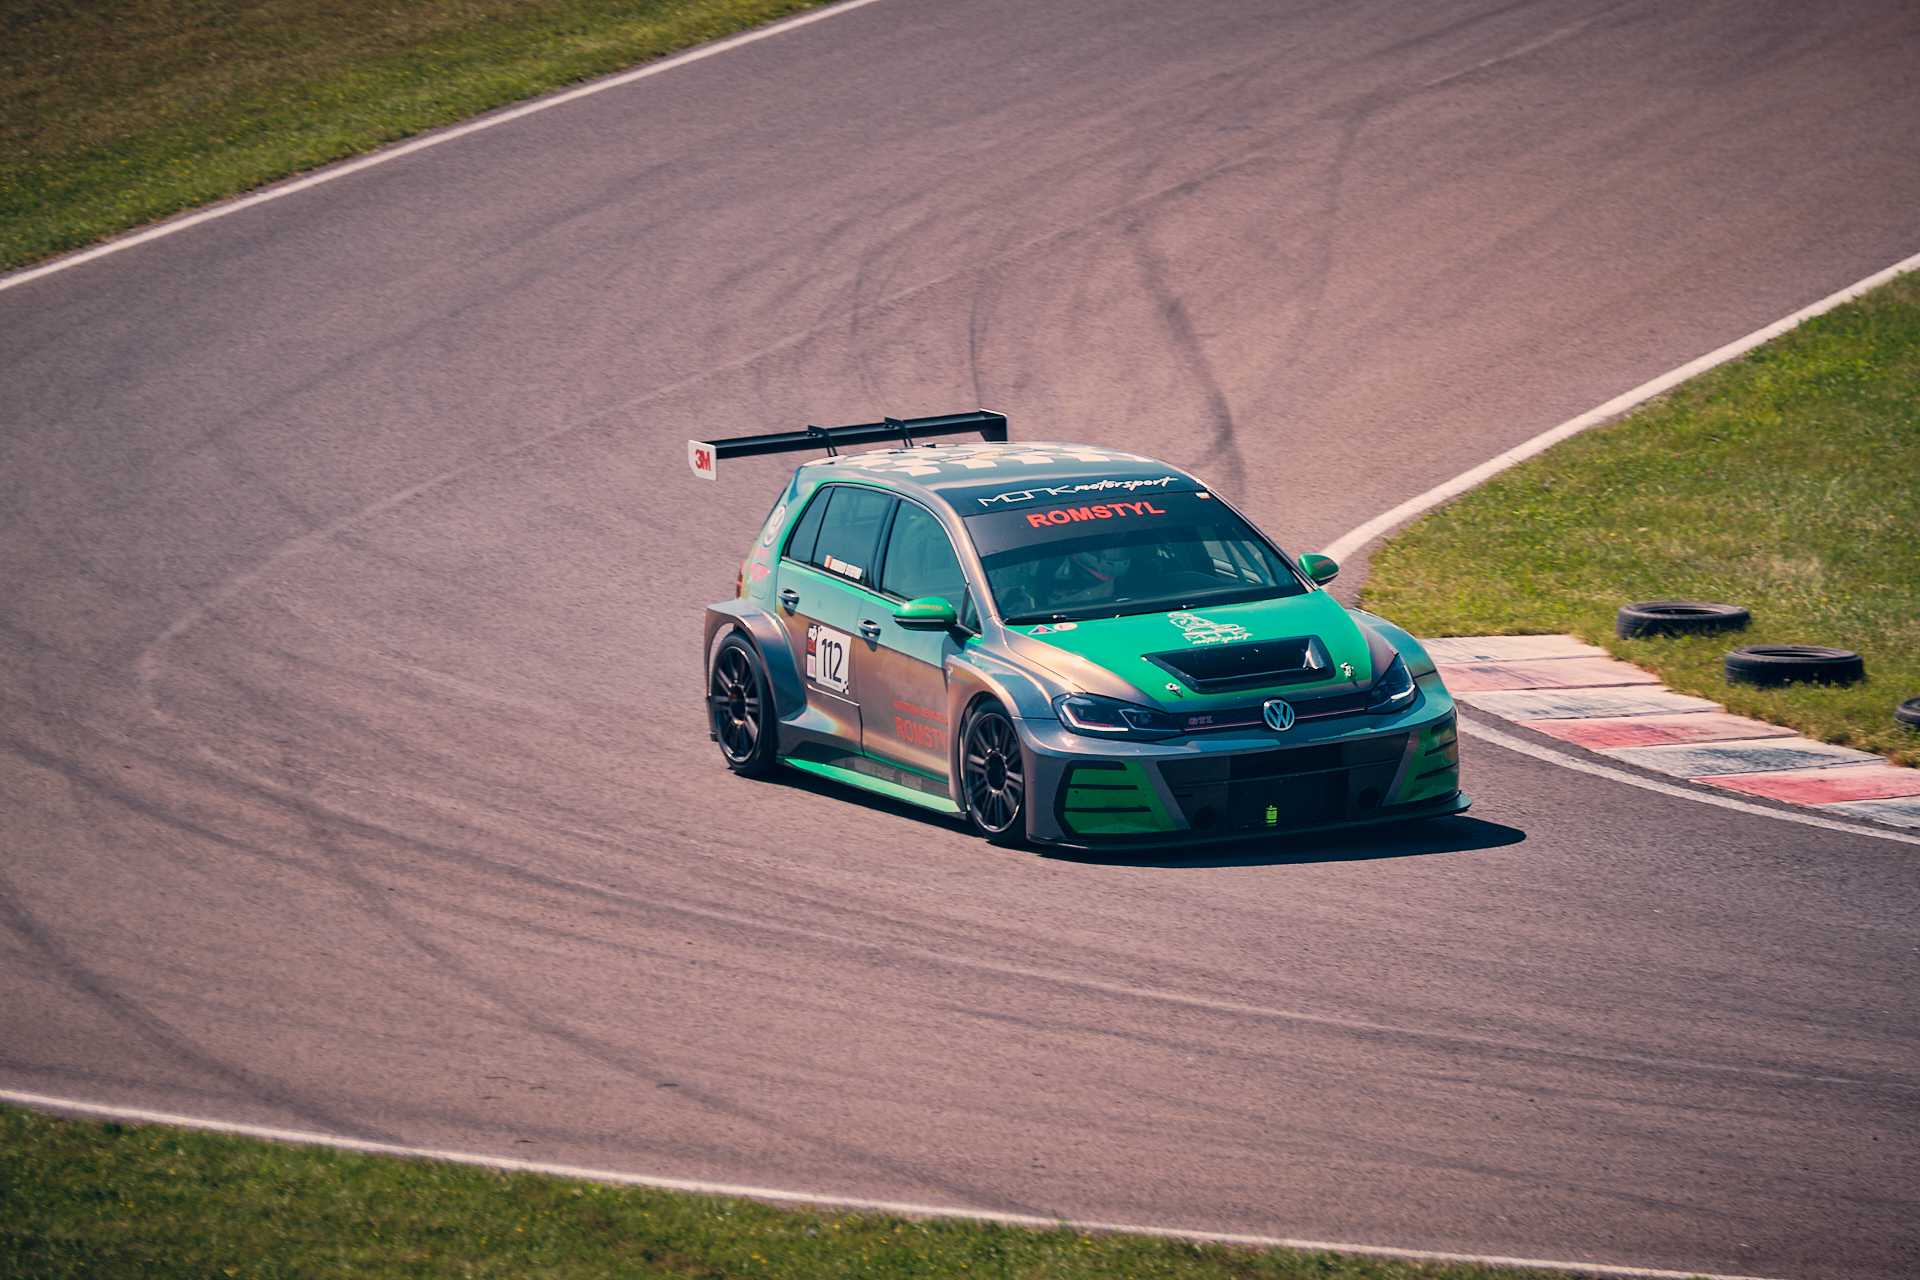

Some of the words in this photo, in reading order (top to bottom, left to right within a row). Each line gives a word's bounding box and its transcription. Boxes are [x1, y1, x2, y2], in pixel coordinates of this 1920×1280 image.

[695, 449, 711, 471] 3M
[1074, 476, 1179, 491] motorsport
[1025, 501, 1167, 528] ROMSTYL
[821, 638, 842, 683] 112
